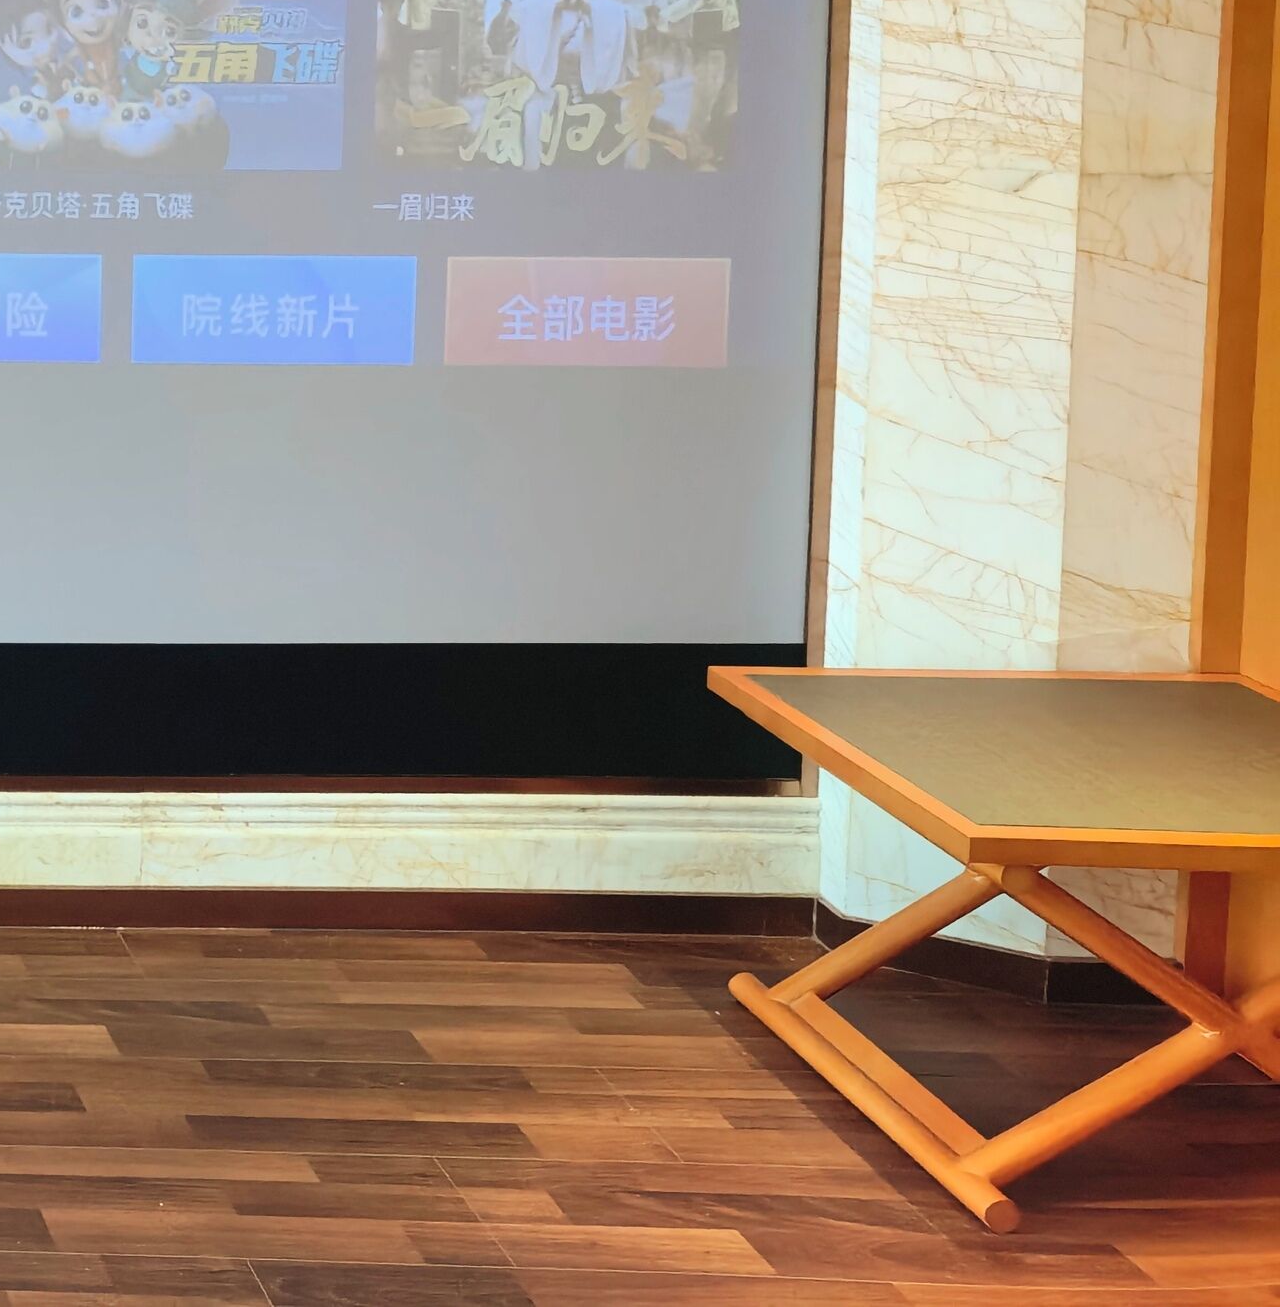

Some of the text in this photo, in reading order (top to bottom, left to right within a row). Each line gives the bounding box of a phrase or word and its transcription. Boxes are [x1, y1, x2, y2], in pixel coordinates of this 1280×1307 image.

[168, 39, 342, 85] 五角飞碟
[395, 76, 688, 166] 一眉归来
[372, 194, 476, 223] 一眉归来
[181, 294, 360, 339] 院线新片
[496, 294, 678, 343] 全部电影
